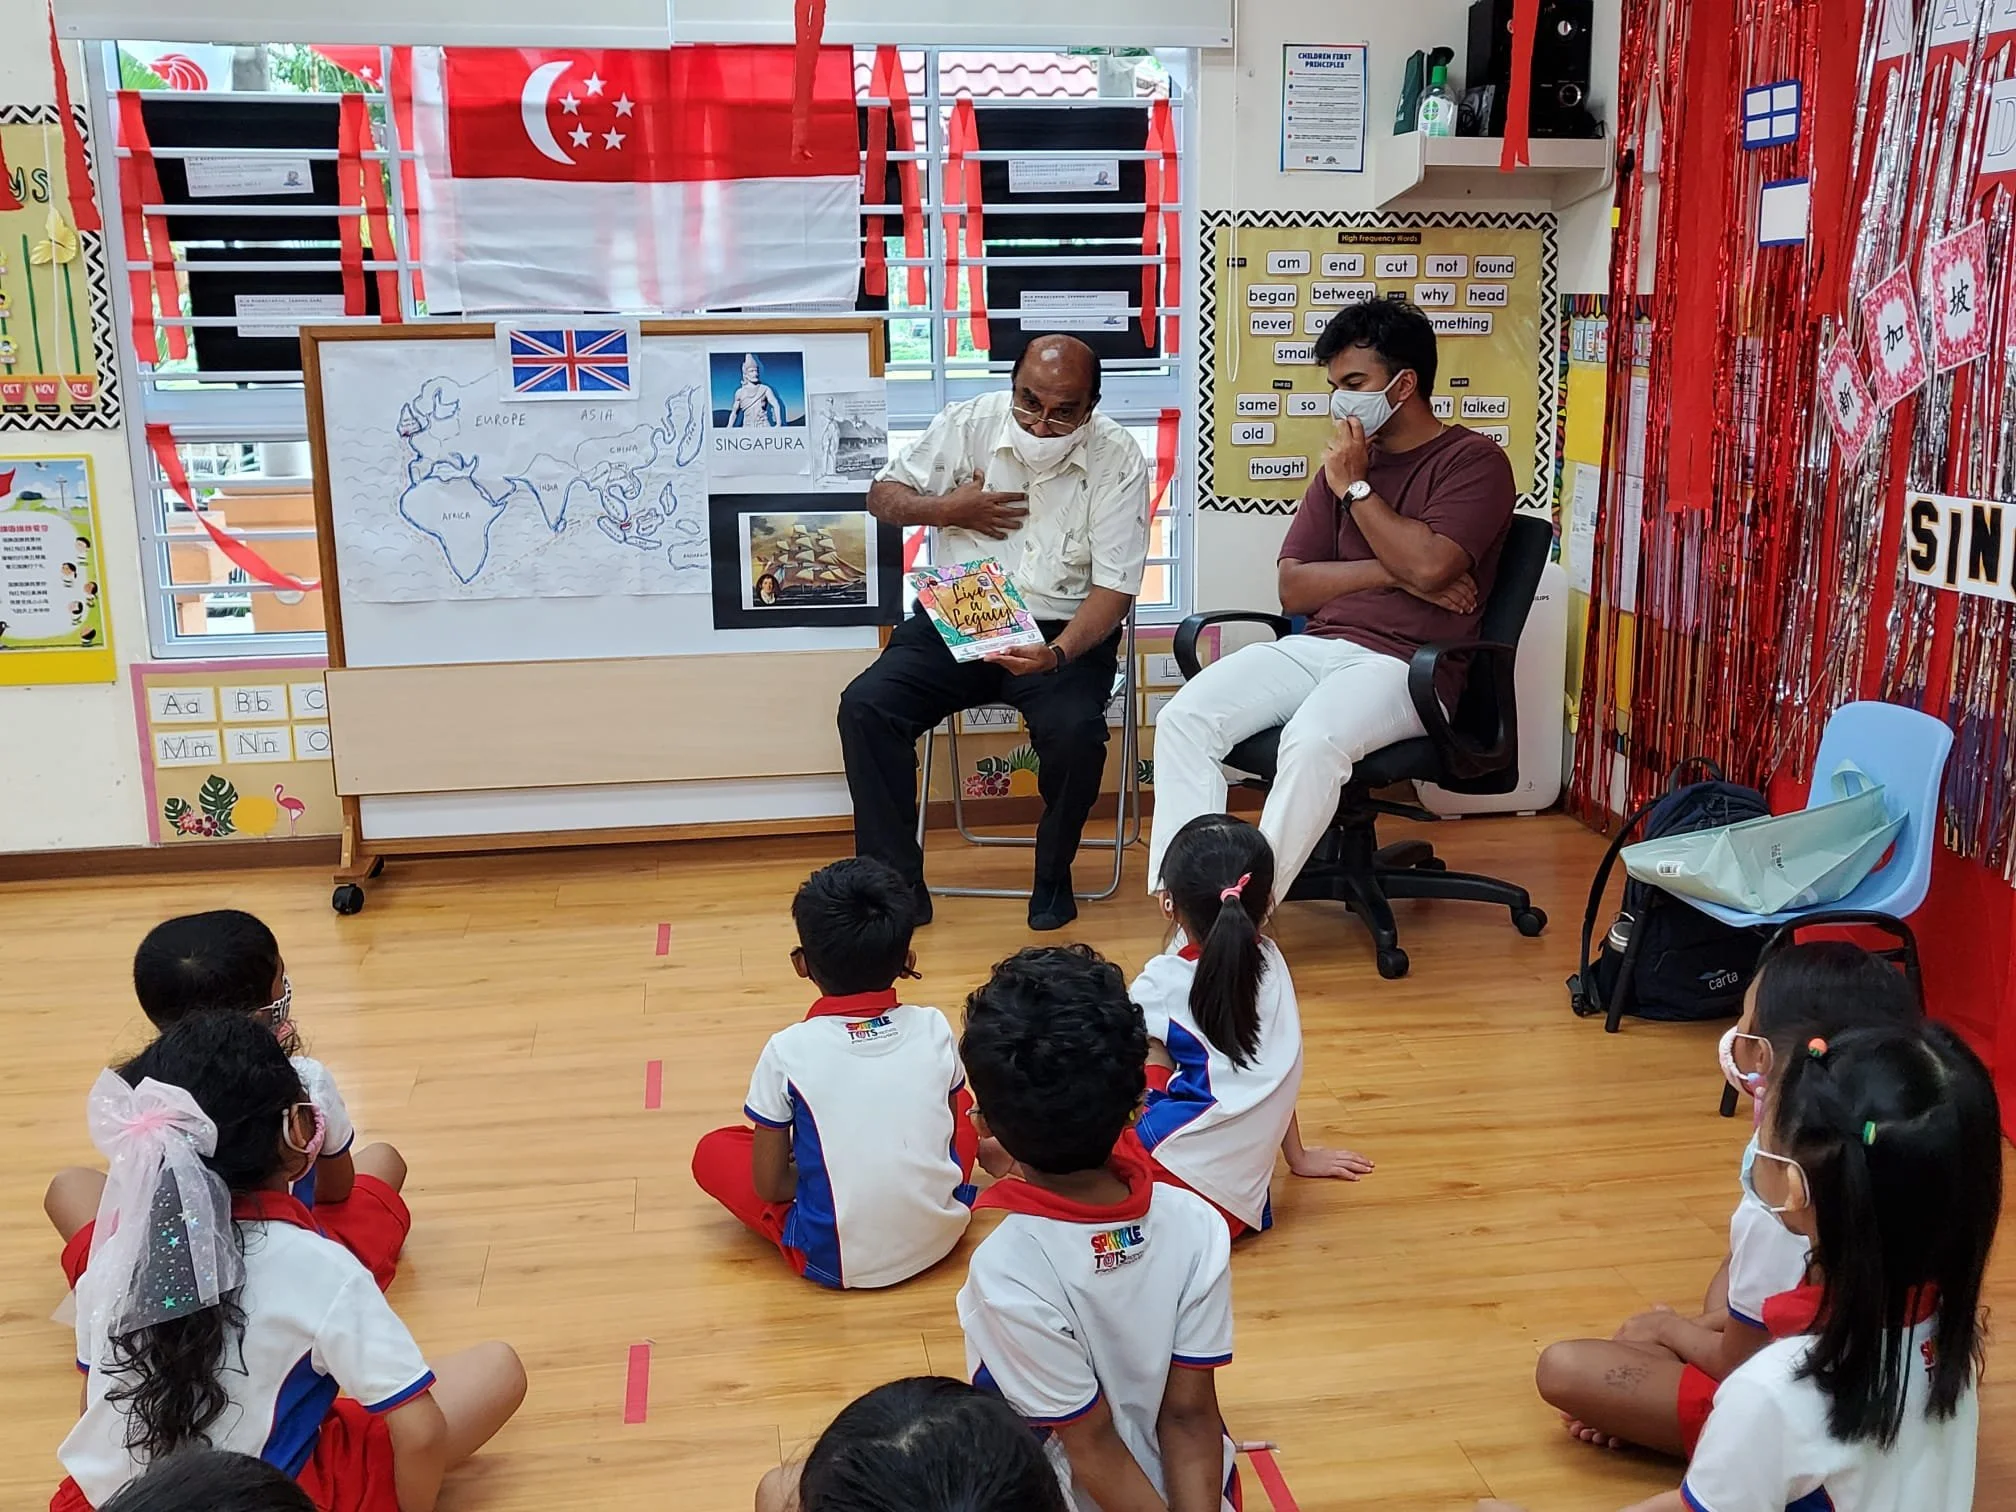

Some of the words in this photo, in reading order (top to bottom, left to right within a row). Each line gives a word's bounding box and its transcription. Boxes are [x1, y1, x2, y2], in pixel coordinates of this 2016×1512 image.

[1297, 52, 1331, 60] CHILDREN
[1332, 53, 1352, 61] FIRST
[1304, 60, 1345, 69] PRINCIPLES
[1277, 257, 1301, 269] am
[1329, 259, 1357, 271] end
[1385, 260, 1408, 273] cut
[1435, 259, 1458, 273] not
[1475, 260, 1514, 274] found
[1249, 289, 1296, 305] began
[1312, 287, 1374, 301] between
[1421, 288, 1449, 303] why
[1469, 289, 1505, 301] head
[1252, 319, 1292, 330] never
[1428, 316, 1489, 332] omething
[1238, 400, 1277, 411] same
[1301, 401, 1316, 411] so
[1463, 401, 1505, 413] talked
[475, 412, 527, 427] EUROPE
[580, 408, 614, 421] ASIA
[1242, 427, 1264, 440] old
[609, 445, 638, 454] CHINA
[715, 437, 805, 452] SINGAPURA
[1251, 461, 1305, 476] thought
[539, 483, 558, 491] INDIA
[442, 511, 471, 522] AFRICA
[1909, 496, 2016, 598] SIN
[951, 583, 987, 604] Live
[970, 602, 983, 612] a
[952, 608, 1012, 635] Legacy
[164, 694, 199, 715] Aa
[236, 691, 269, 713] Bb
[163, 738, 212, 759] Mm
[239, 734, 276, 754] Nn
[1708, 971, 1739, 990] carta
[846, 1015, 893, 1031] SPARKLE
[848, 1029, 878, 1040] TOTS
[1091, 1225, 1145, 1253] SPARKLE
[1094, 1249, 1127, 1269] TOTS
